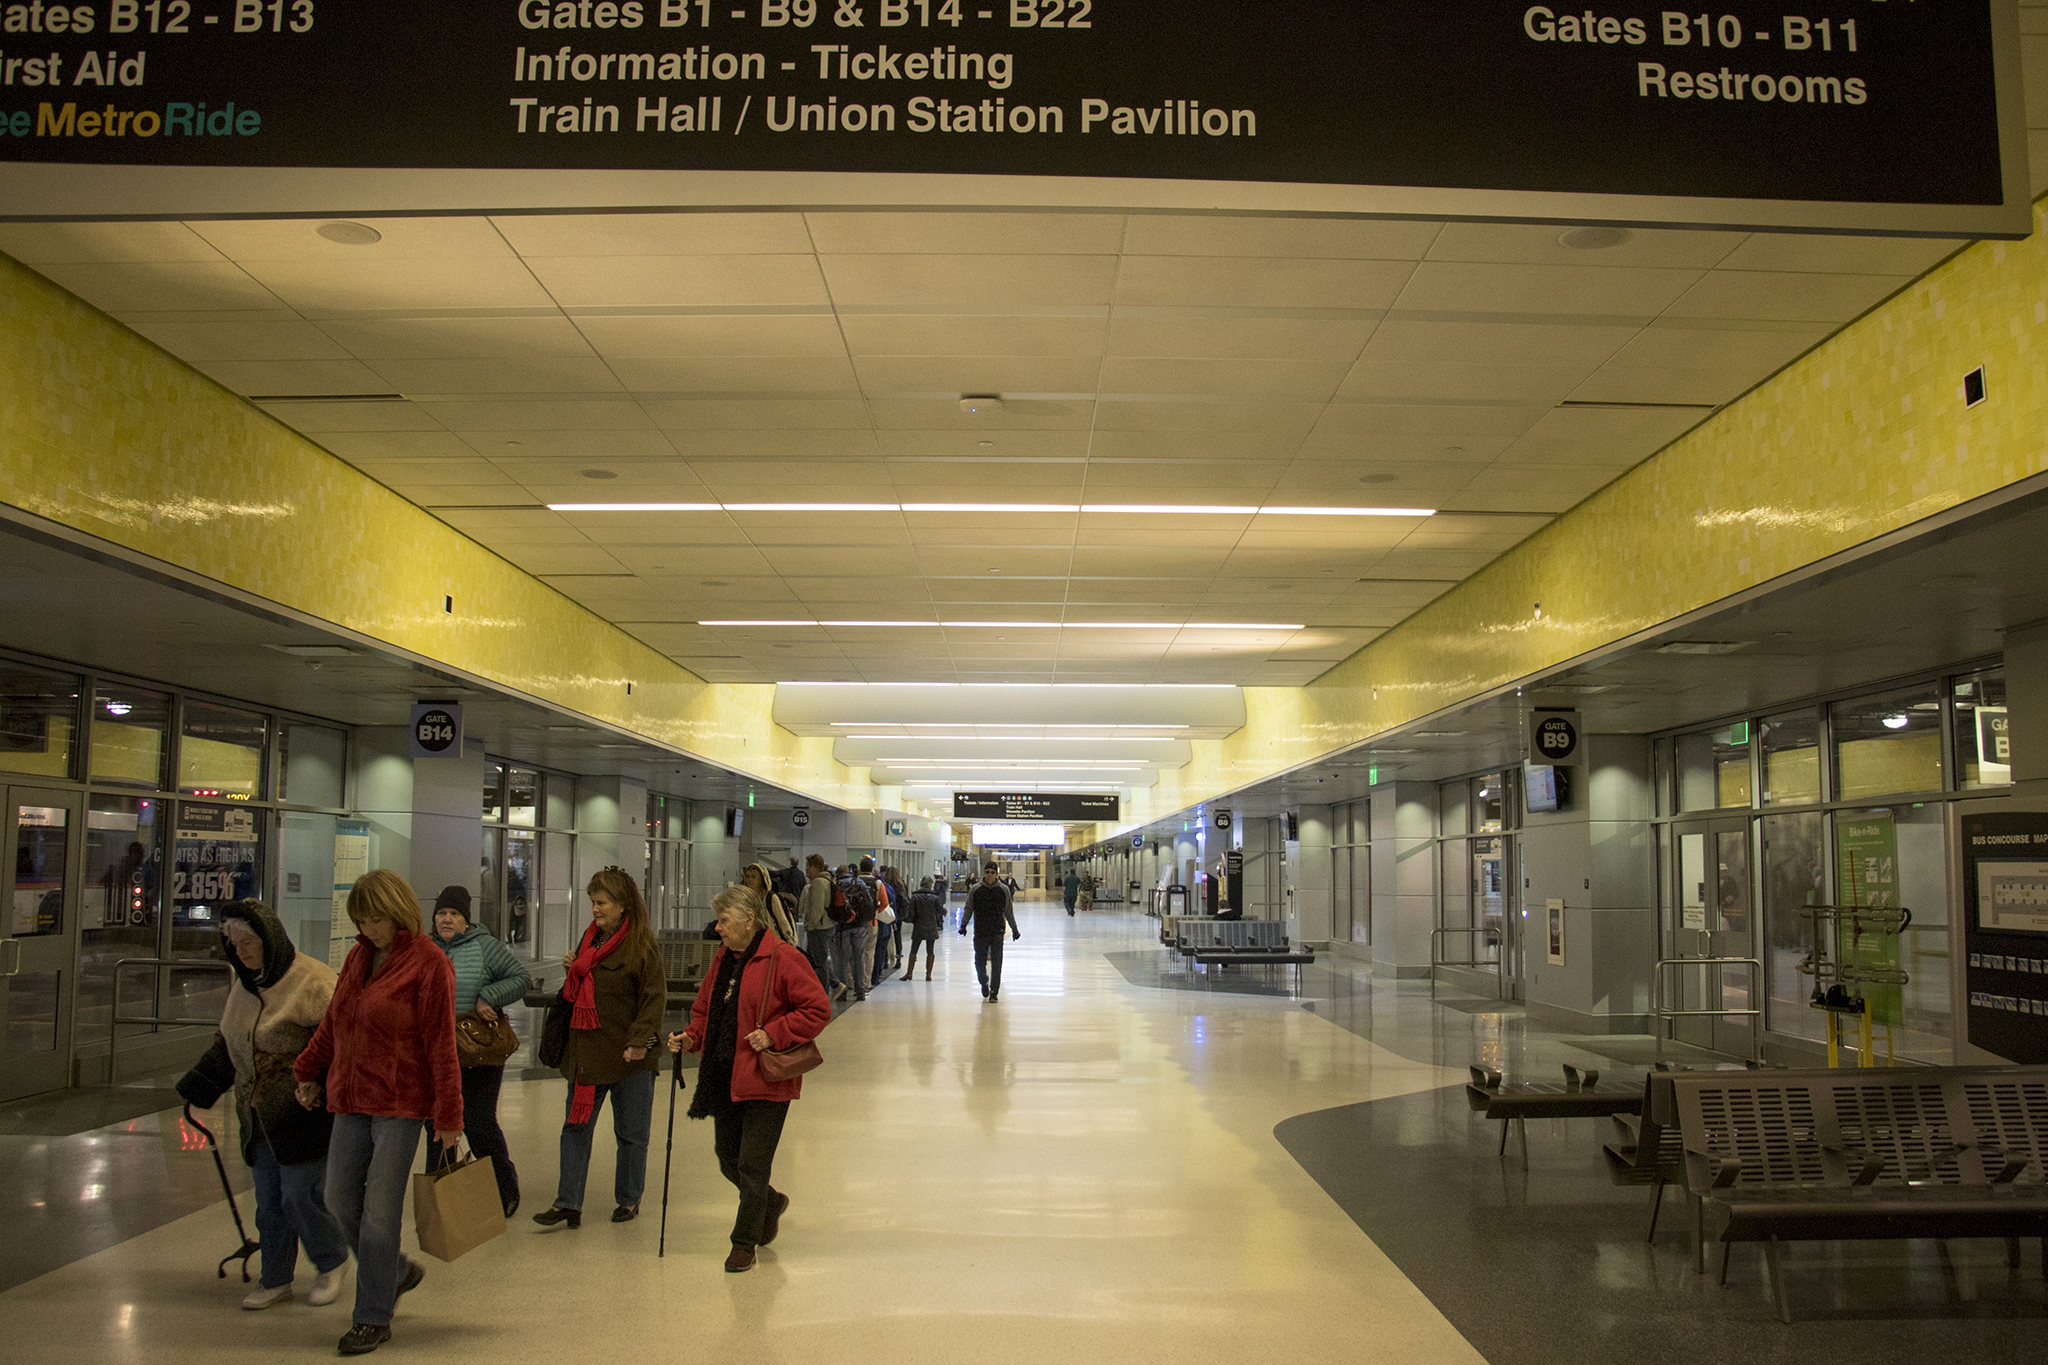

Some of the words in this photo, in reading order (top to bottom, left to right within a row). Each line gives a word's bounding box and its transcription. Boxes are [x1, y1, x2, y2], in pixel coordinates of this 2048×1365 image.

[0, 0, 95, 33] ates
[109, 0, 191, 33] B12
[203, 15, 219, 24] -
[233, 0, 315, 33] B13
[517, 0, 644, 30] Gates
[659, 0, 711, 28] B1
[731, 10, 746, 19] -
[760, 0, 818, 28] B9
[833, 0, 864, 28] &
[879, 0, 964, 28] B14
[977, 10, 993, 19] -
[1009, 0, 1093, 29] B22
[1523, 5, 1648, 45] Gates
[1661, 11, 1742, 49] B10
[1755, 31, 1770, 40] -
[1782, 15, 1858, 52] B11
[72, 50, 146, 87] Aid
[514, 45, 766, 81] Information
[780, 62, 796, 71] -
[810, 44, 1014, 89] Ticketing
[1637, 61, 1868, 105] Restrooms
[509, 97, 620, 133] Train
[636, 96, 722, 132] Hall
[734, 95, 752, 136] /
[766, 96, 896, 132] Union
[906, 96, 1064, 133] Station
[1081, 98, 1257, 137] Pavilion
[419, 725, 453, 740] B14
[425, 715, 447, 723] GATE
[1545, 722, 1567, 730] GATE
[1543, 732, 1570, 748] B9
[174, 847, 199, 862] ATES
[1972, 836, 1986, 845] BUS
[1987, 834, 2030, 845] CONCOURSE
